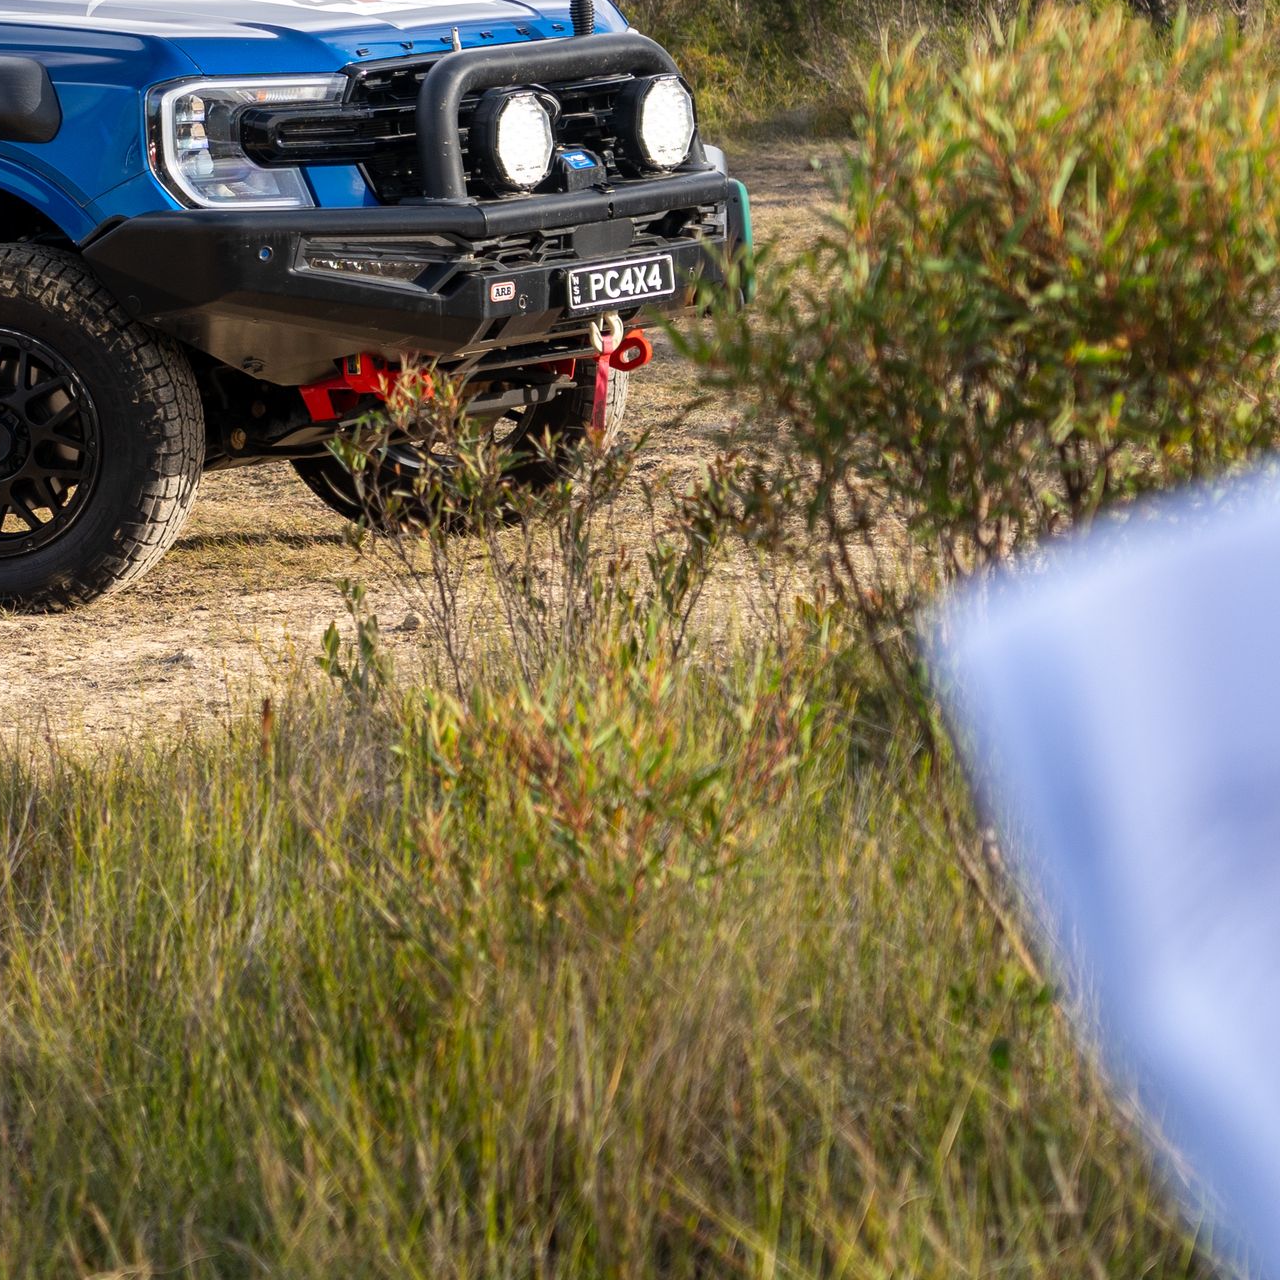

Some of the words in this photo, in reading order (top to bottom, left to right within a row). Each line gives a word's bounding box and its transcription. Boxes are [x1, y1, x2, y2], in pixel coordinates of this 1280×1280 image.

[356, 23, 566, 57] EVERES
[494, 286, 512, 297] ARB
[571, 273, 582, 305] NSW
[590, 263, 663, 301] PC4X4
